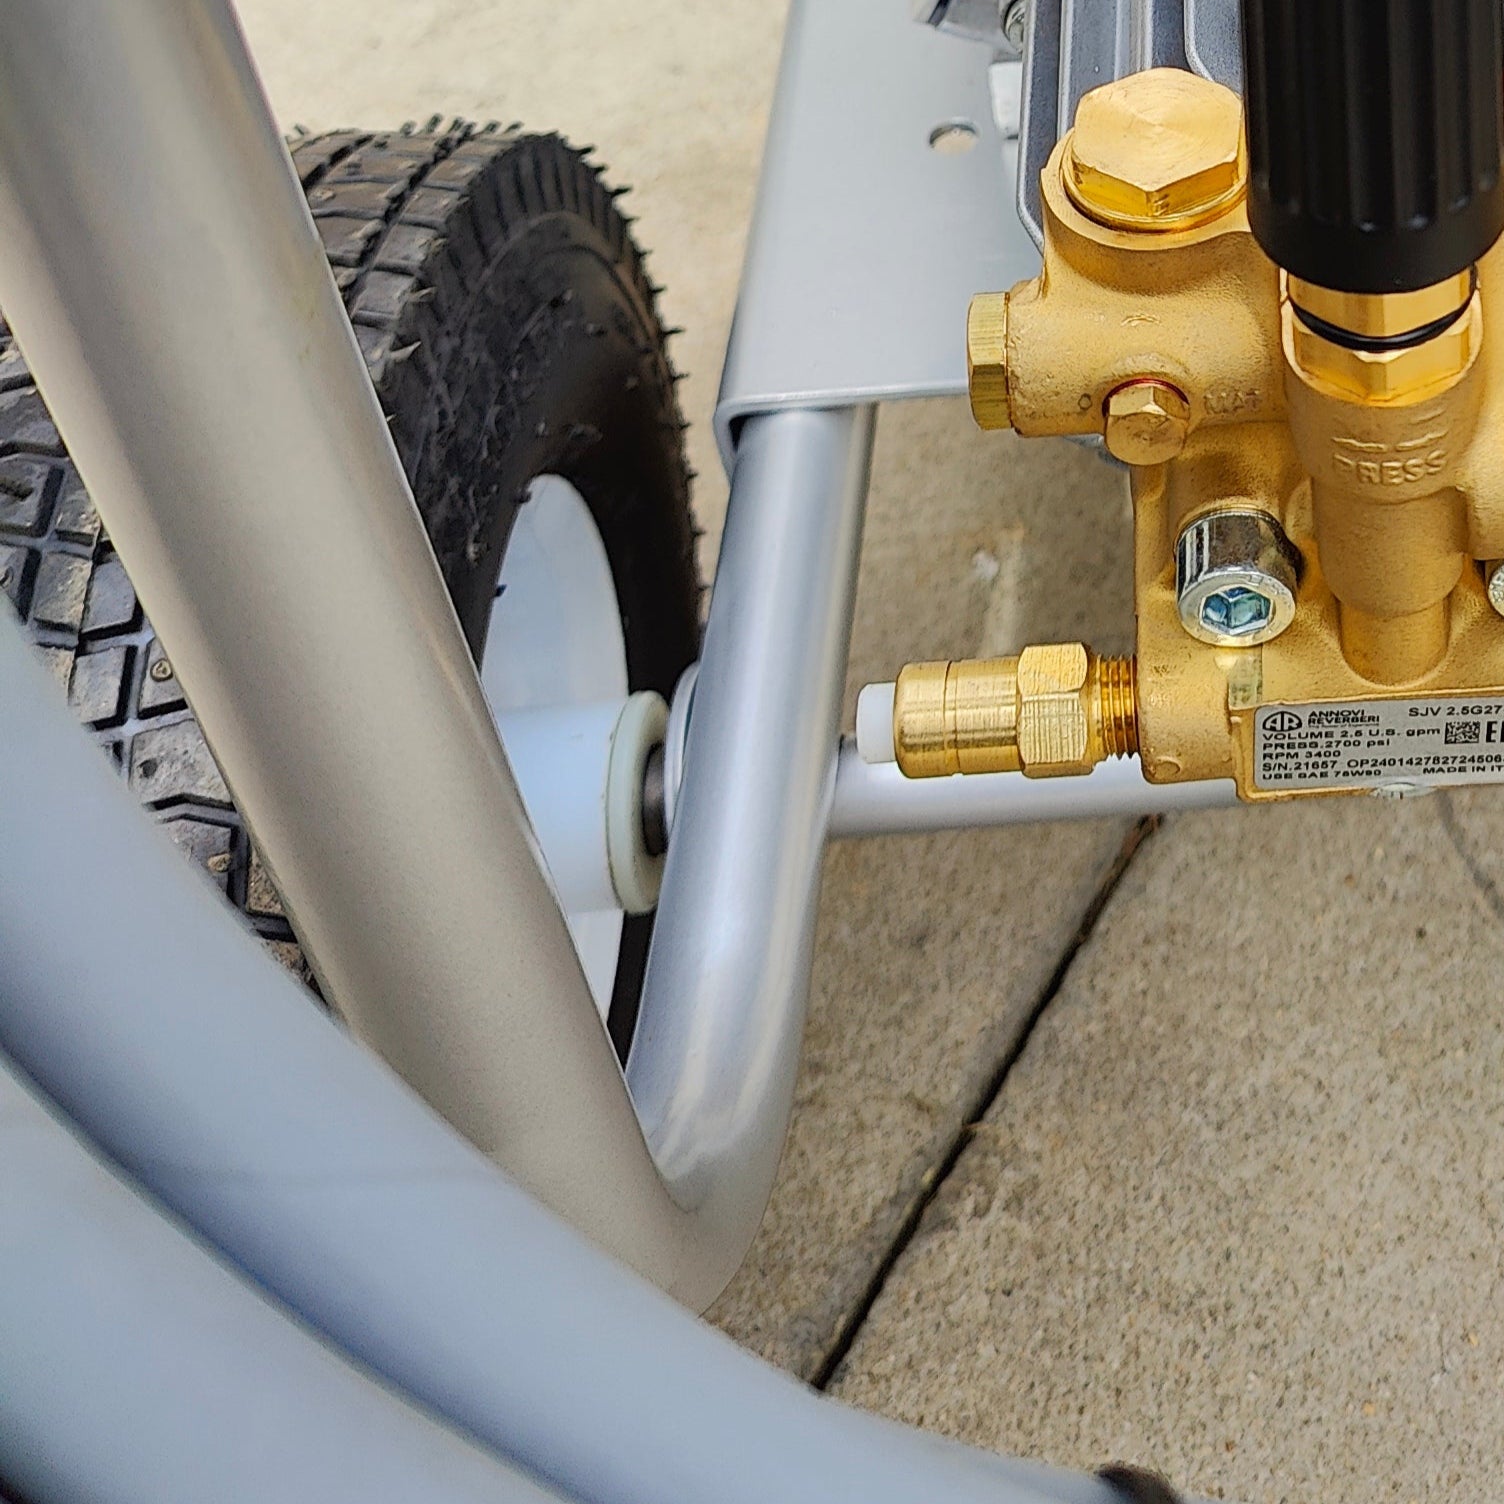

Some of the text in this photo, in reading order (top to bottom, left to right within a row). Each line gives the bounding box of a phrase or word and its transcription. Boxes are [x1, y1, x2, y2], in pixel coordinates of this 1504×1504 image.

[1332, 449, 1448, 486] PRESS
[1308, 709, 1365, 718] ANNOVI
[1409, 706, 1442, 717] SJV
[1308, 715, 1380, 725] REVERBERI
[1263, 731, 1335, 740] VOLUME
[1406, 727, 1441, 737] gpm
[1366, 738, 1390, 748] psi
[1263, 752, 1299, 761] RPM
[1422, 764, 1467, 775] MADE
[1472, 764, 1486, 773] IN
